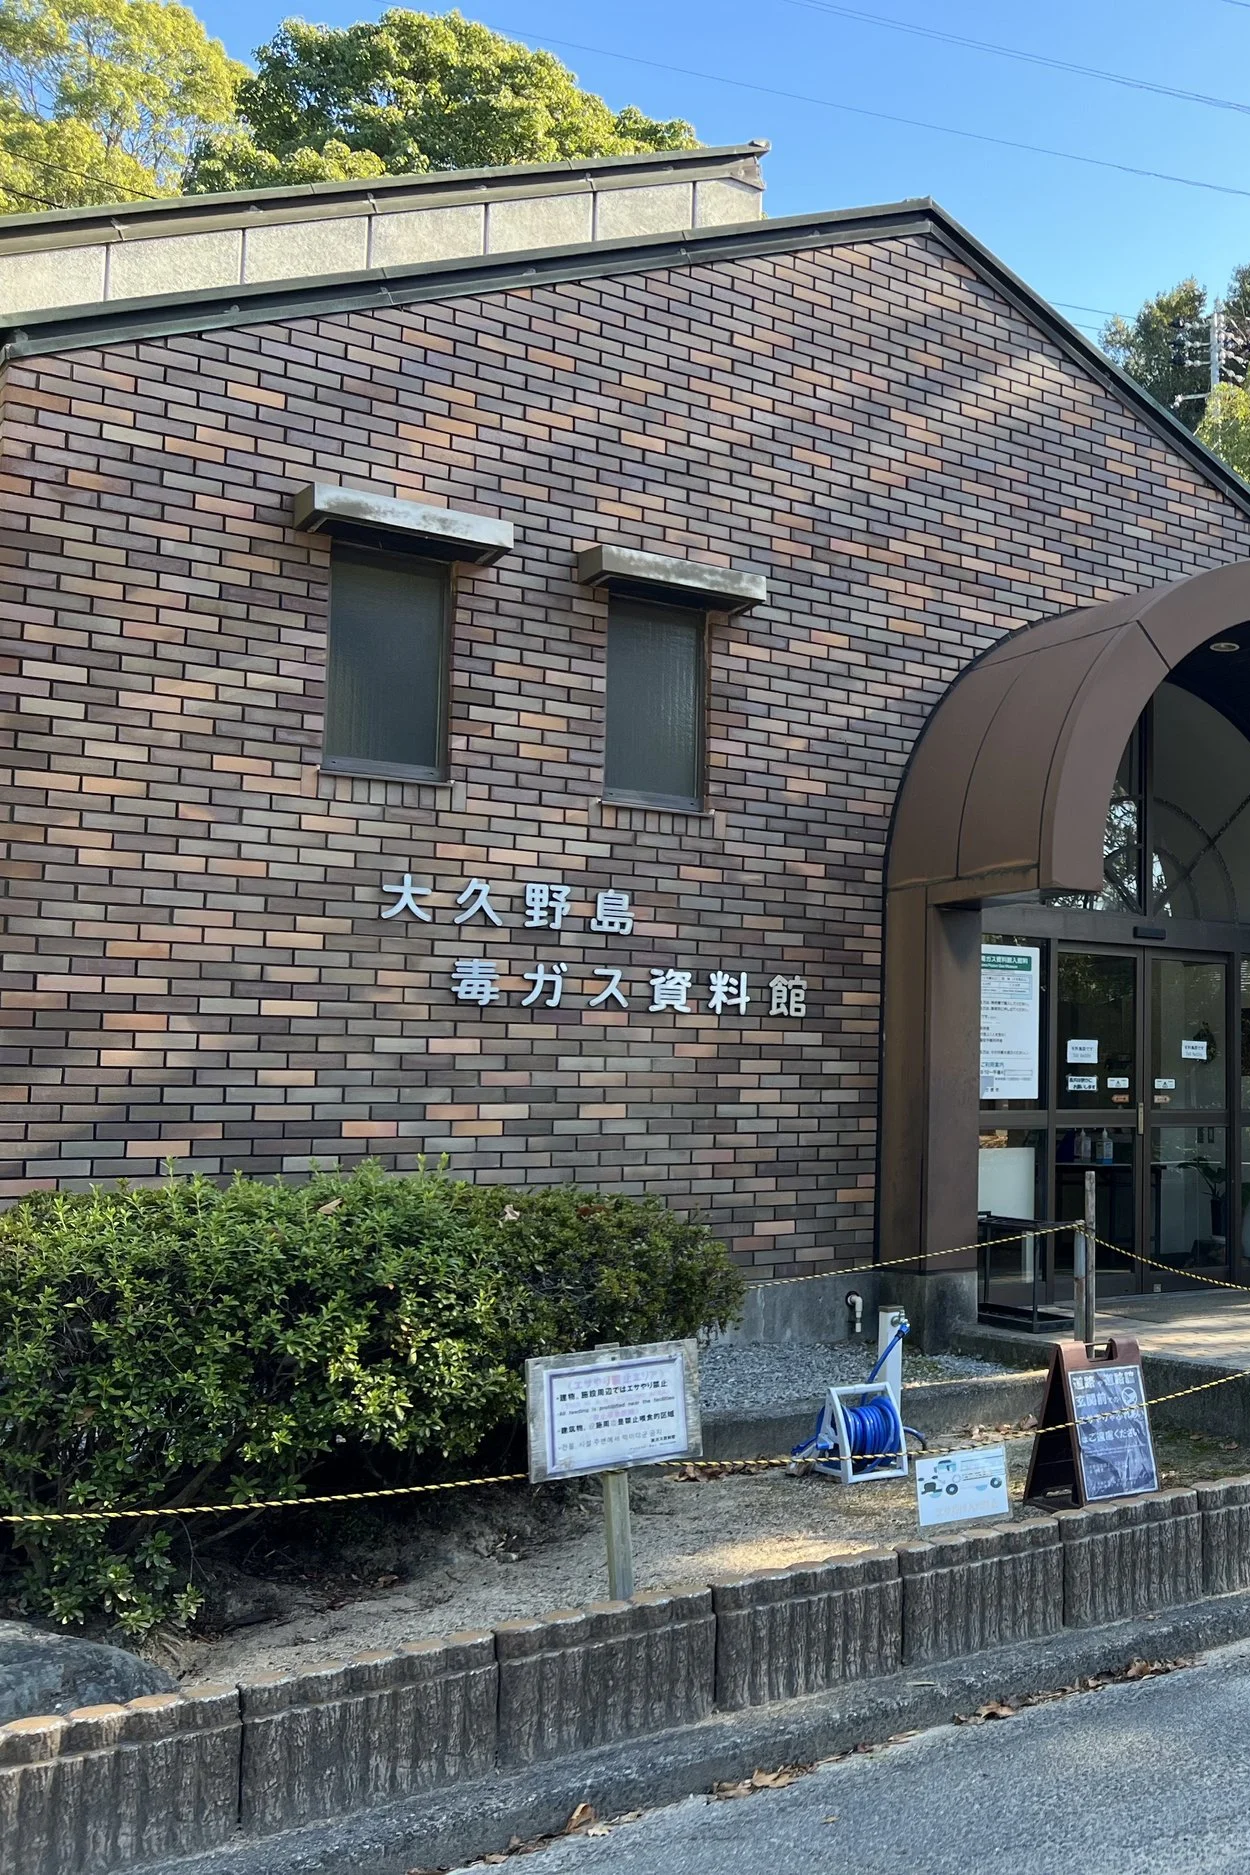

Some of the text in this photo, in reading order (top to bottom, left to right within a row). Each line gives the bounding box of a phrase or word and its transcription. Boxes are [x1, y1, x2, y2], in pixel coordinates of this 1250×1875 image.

[380, 873, 635, 936] 大久野島
[451, 958, 808, 1018] 毒ガス資料館
